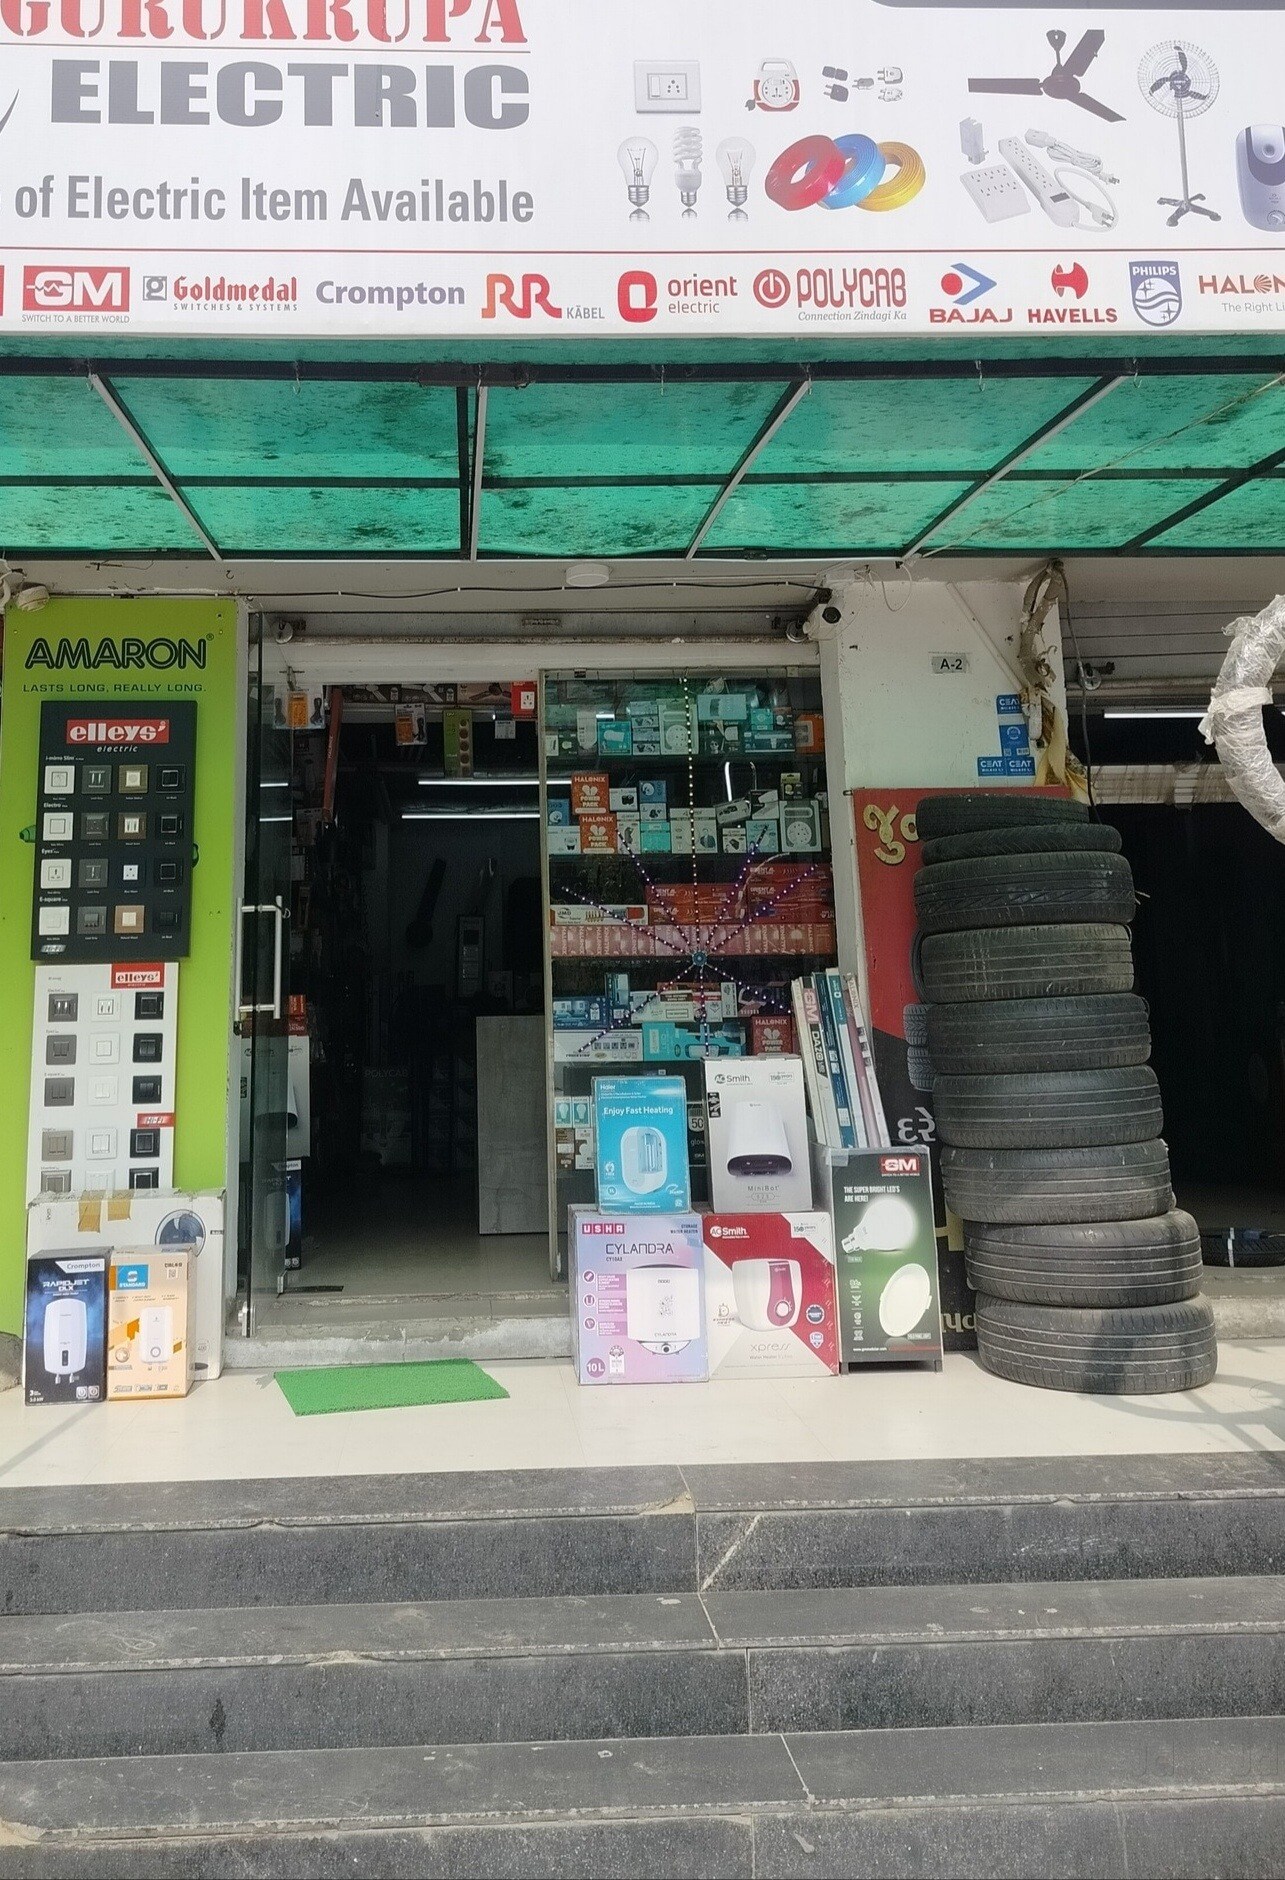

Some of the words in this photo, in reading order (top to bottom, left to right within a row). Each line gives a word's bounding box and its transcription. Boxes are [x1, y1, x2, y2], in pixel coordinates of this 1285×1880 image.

[51, 59, 531, 130] ELECTRIC
[15, 175, 55, 219] of
[67, 175, 226, 221] Electric
[241, 177, 327, 221] Item
[340, 177, 535, 223] Available
[1132, 265, 1178, 277] PHILIPS
[173, 275, 298, 302] Goldmedal
[667, 273, 739, 297] orient
[796, 267, 907, 309] POLYCAB
[315, 280, 466, 311] Crompton
[481, 273, 563, 319] RR
[173, 303, 231, 311] SWITCHES
[237, 303, 243, 311] &
[249, 303, 298, 312] SYSTEMS
[668, 300, 720, 314] electric
[1221, 302, 1242, 313] The
[1244, 302, 1274, 314] Right
[22, 314, 51, 323] SWITCH
[53, 314, 65, 323] TO
[65, 315, 73, 323] A
[74, 315, 100, 324] BETTER
[102, 315, 130, 324] WORLD
[798, 310, 852, 322] Connection
[853, 310, 892, 323] Zindagi
[893, 310, 908, 321] Ka
[929, 308, 1013, 324] BAJAJ
[1028, 307, 1118, 324] HAVELLS
[24, 637, 207, 670] AMARON
[940, 658, 963, 670] A-2
[22, 683, 64, 693] LASTS
[69, 683, 110, 694] LONG,
[113, 683, 162, 692] REALLY
[167, 683, 207, 692] LONG.
[999, 698, 1020, 706] CEA
[96, 744, 139, 753] electric
[980, 760, 1003, 768] CEAT
[1008, 760, 1032, 768] CEAT
[755, 1018, 788, 1026] HALONIX
[727, 1075, 750, 1083] Smith
[603, 1106, 625, 1116] Enjoy
[625, 1105, 643, 1115] Fast
[643, 1105, 674, 1115] Heating
[843, 1186, 853, 1194] THE
[853, 1186, 869, 1194] SUPER
[844, 1195, 854, 1203] ARE
[583, 1224, 625, 1234] USHA
[722, 1227, 748, 1236] Smith
[605, 1243, 674, 1255] CYLANDRA
[66, 1262, 101, 1271] Crompton
